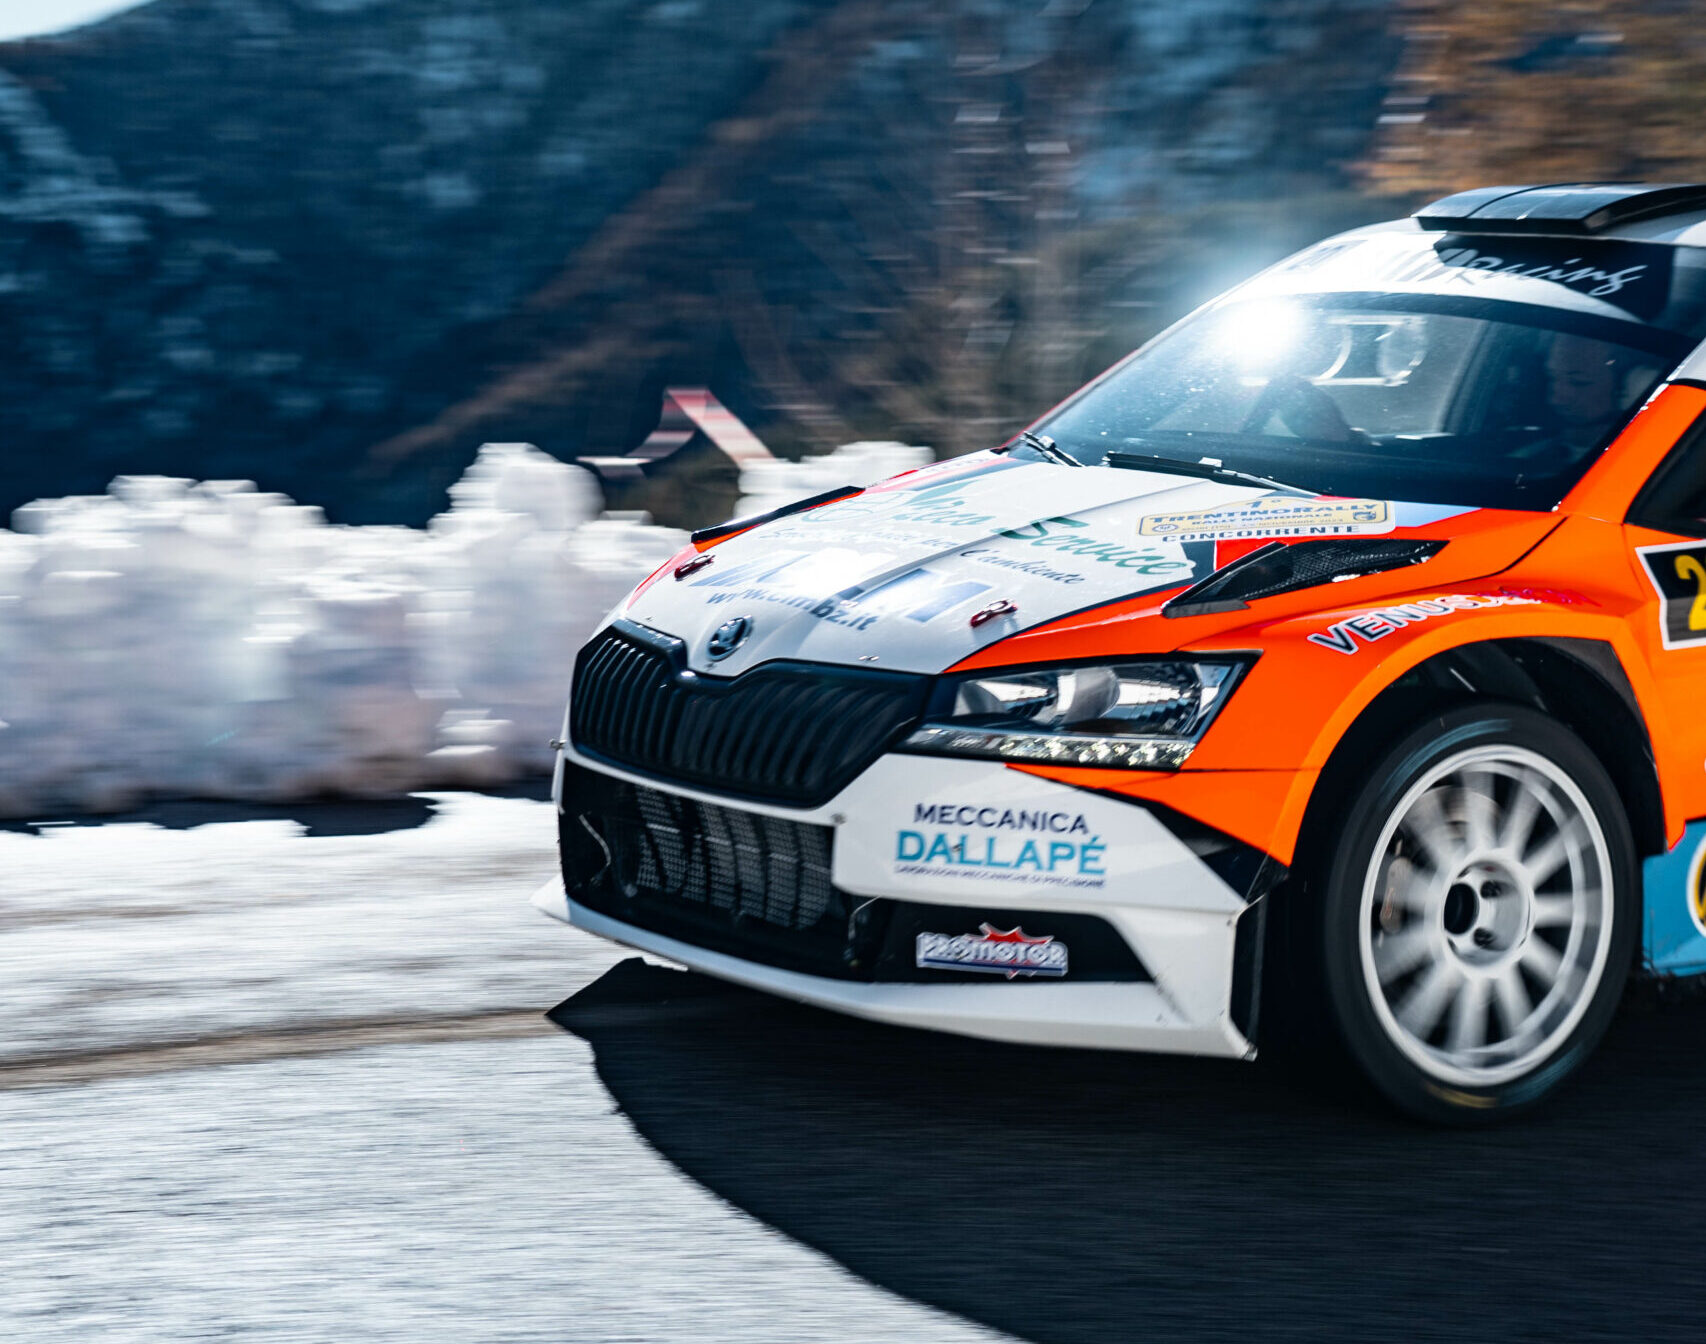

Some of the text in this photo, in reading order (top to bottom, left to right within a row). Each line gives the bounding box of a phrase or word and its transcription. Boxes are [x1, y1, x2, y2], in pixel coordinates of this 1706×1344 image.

[1150, 504, 1377, 523] TRENTINORALLY
[991, 516, 1187, 575] Service
[1161, 525, 1360, 542] CONCORRENTE
[913, 803, 1089, 834] MECCANICA
[896, 830, 1107, 875] DALLAPÉ
